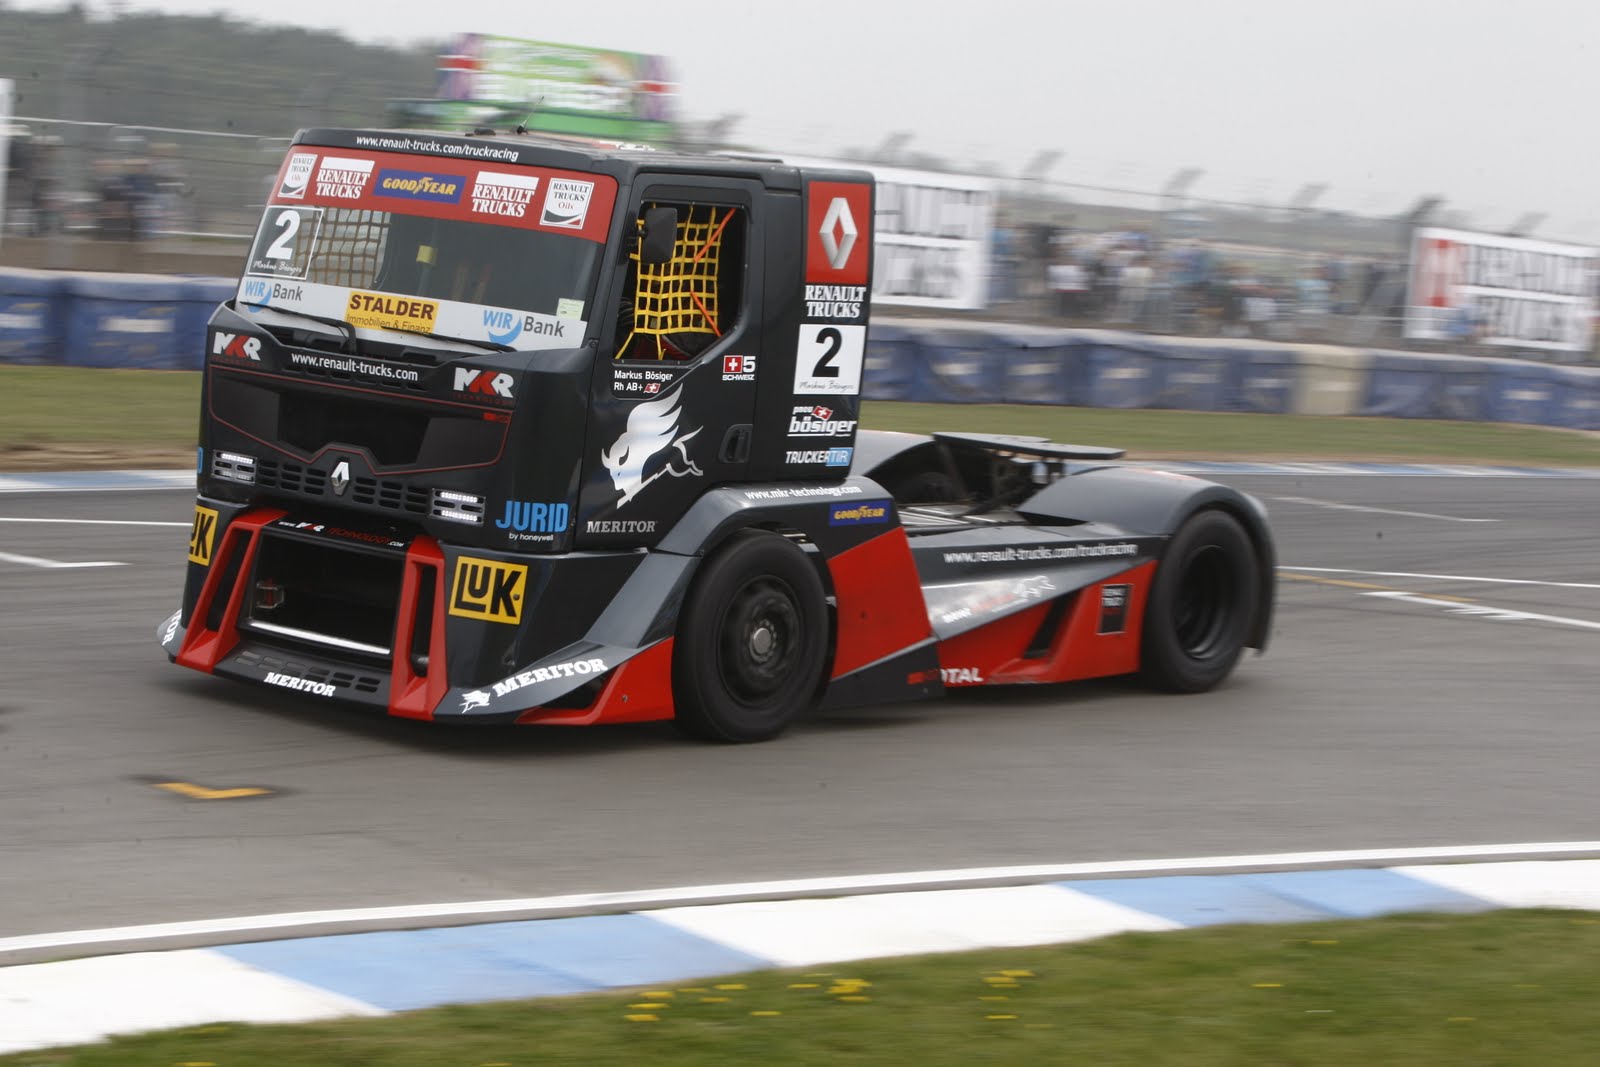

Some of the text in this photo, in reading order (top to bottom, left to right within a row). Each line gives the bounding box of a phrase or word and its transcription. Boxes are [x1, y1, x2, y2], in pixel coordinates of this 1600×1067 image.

[356, 136, 519, 162] www.renault-trucks.com/truckracing
[316, 169, 370, 186] RENAULT
[382, 177, 456, 195] GOODYEAR
[315, 182, 362, 199] TRUCKS
[471, 184, 535, 203] RENAULT
[553, 182, 589, 193] RENAULT
[553, 191, 585, 202] TRUCKS
[472, 199, 526, 217] TRUCKS
[558, 201, 574, 210] Oils
[265, 210, 301, 260] 2
[244, 281, 303, 301] WIR Bank
[804, 285, 866, 302] RENAULT
[350, 294, 434, 320] STALDER
[806, 301, 860, 318] TRUCKS
[346, 314, 391, 328] Immobilien
[402, 320, 431, 334] Finanz
[483, 310, 565, 337] WIR Bank
[213, 332, 261, 361] MKR
[811, 327, 842, 378] 2
[291, 353, 418, 382] www.renault-trucks.com
[614, 370, 673, 382] Markus Bösiger
[453, 367, 514, 398] MKR
[614, 382, 643, 391] Rh AB+
[788, 416, 857, 436] bösiger
[745, 486, 862, 500] www.mkr-technology.com
[495, 500, 568, 533] JURID
[833, 505, 885, 520] GOODYEAR
[586, 521, 656, 533] MERITOR
[509, 532, 554, 542] by honeywell
[454, 562, 522, 617] LUK
[264, 672, 336, 697] MERITOR
[492, 658, 608, 697] MERITOR
